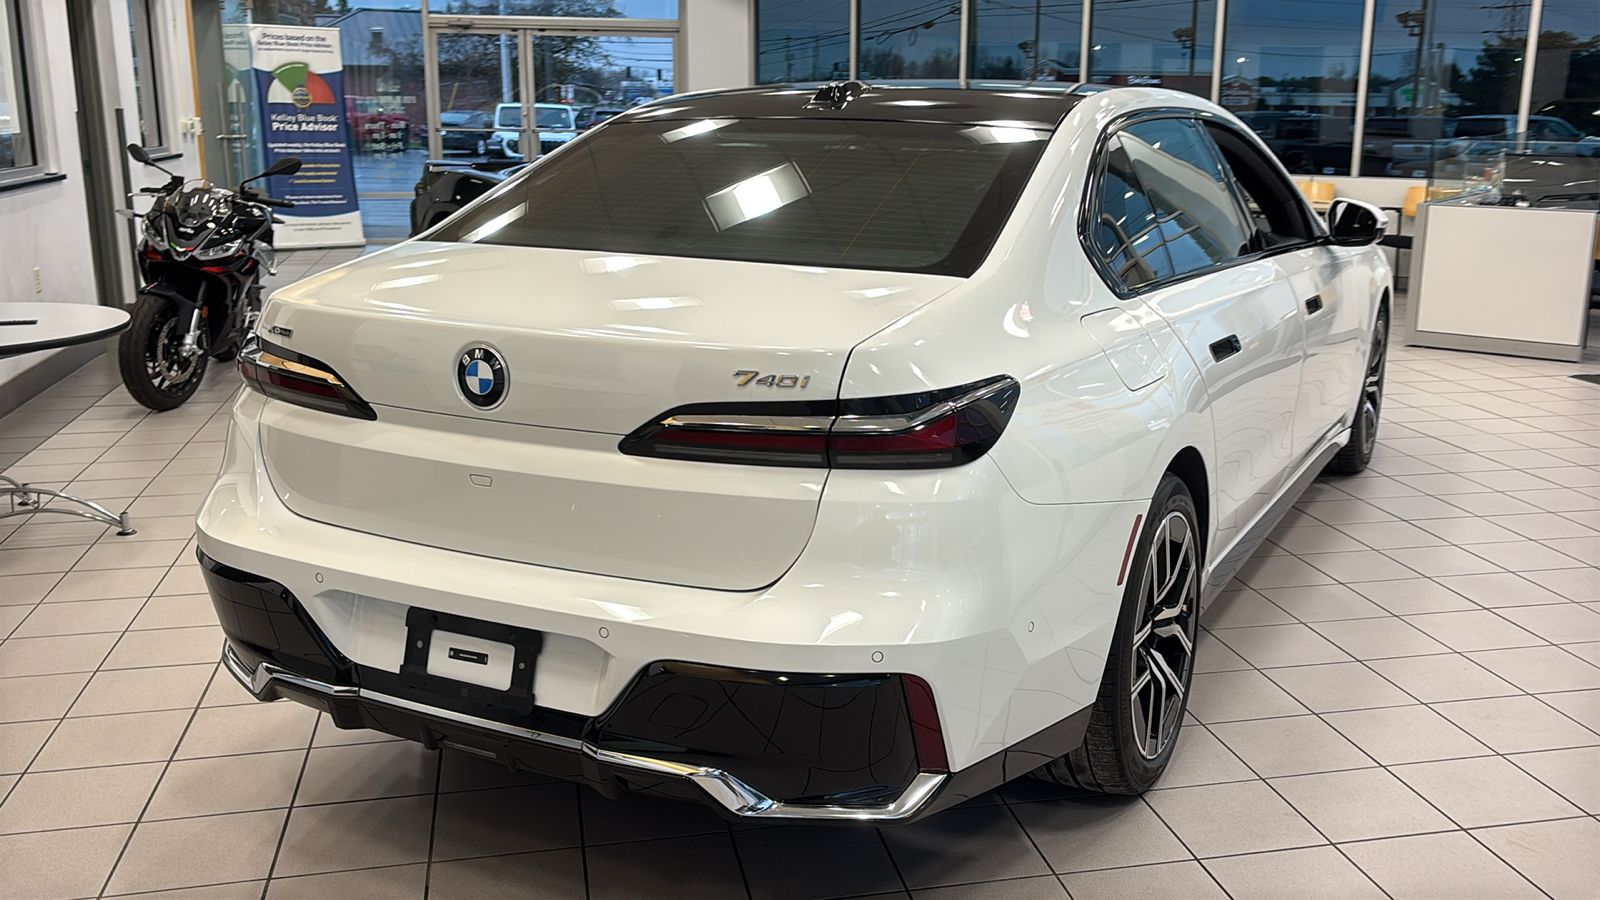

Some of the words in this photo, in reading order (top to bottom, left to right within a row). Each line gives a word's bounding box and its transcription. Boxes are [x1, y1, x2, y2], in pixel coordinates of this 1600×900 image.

[270, 113, 296, 123] Kelley
[297, 113, 316, 122] Blue
[317, 114, 339, 122] Book
[271, 122, 299, 131] Price
[300, 122, 339, 131] Advisor
[462, 349, 501, 370] BMW
[733, 369, 811, 388] 740i
